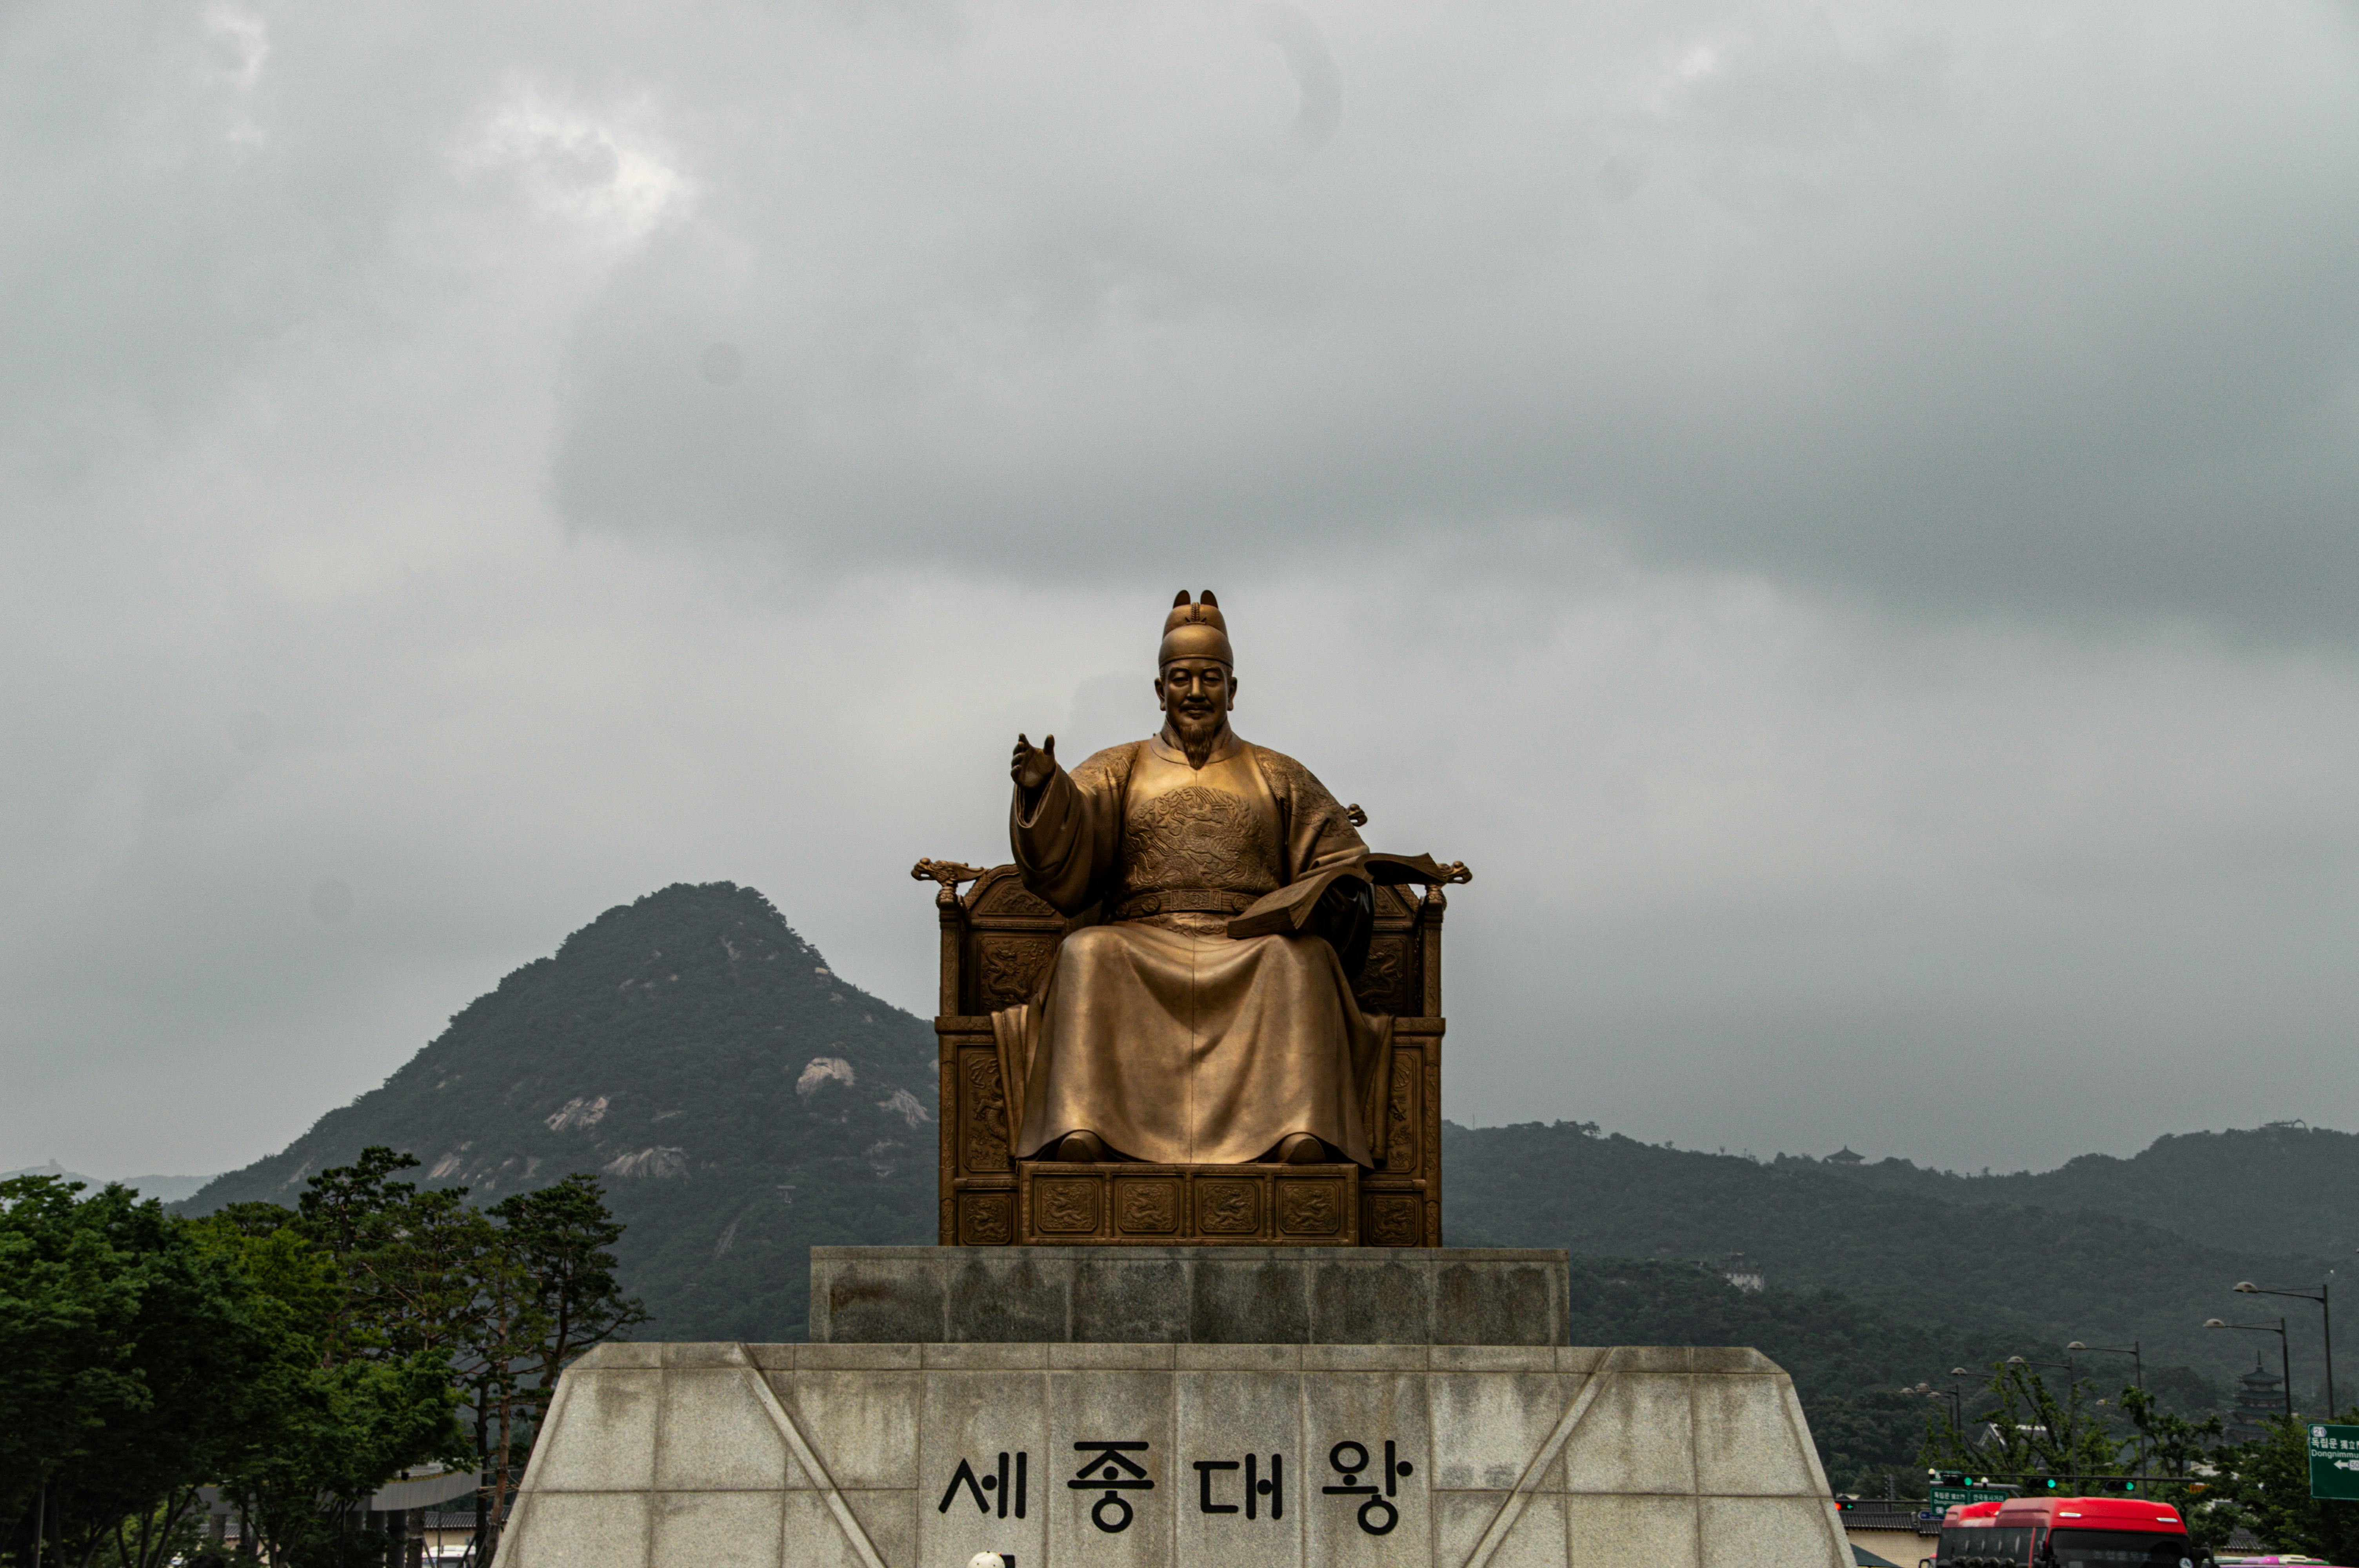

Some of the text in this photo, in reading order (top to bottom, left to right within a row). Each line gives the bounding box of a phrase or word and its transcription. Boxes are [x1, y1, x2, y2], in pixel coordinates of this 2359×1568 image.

[2311, 1437, 2337, 1449] 독립문
[2311, 1449, 2359, 1459] Dongnimmu
[938, 1440, 1414, 1535] 세종대왕
